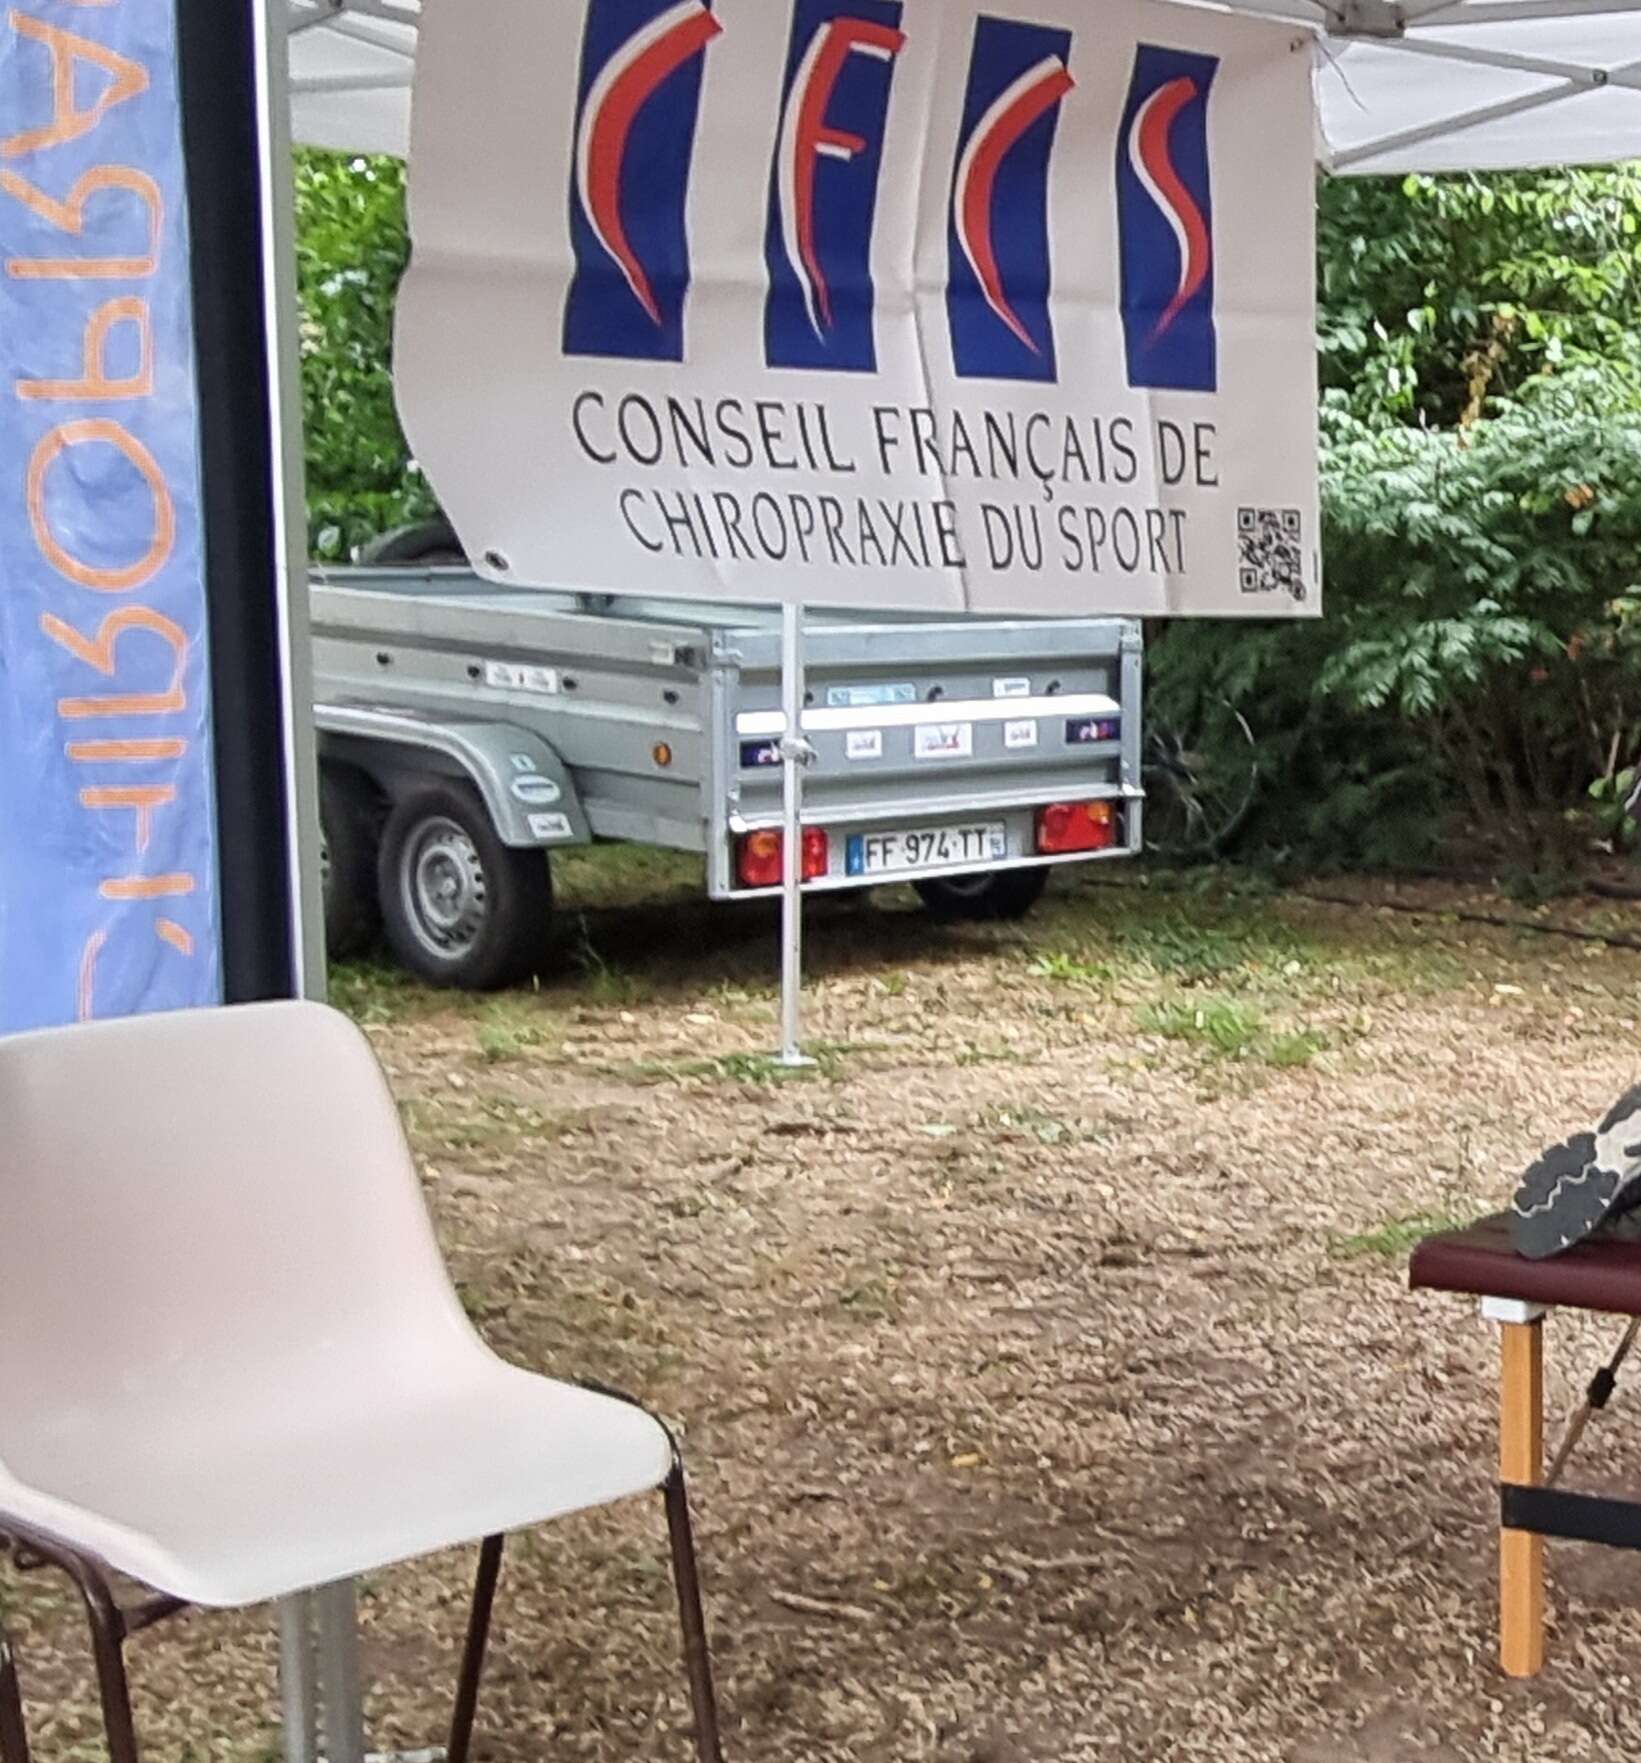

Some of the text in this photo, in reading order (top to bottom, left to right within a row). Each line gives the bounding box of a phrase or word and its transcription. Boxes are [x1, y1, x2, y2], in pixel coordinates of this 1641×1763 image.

[572, 389, 1220, 502] CONSEIL FRANÇAIS DE
[618, 488, 1188, 574] CHIROPRAXIE DU SPORT
